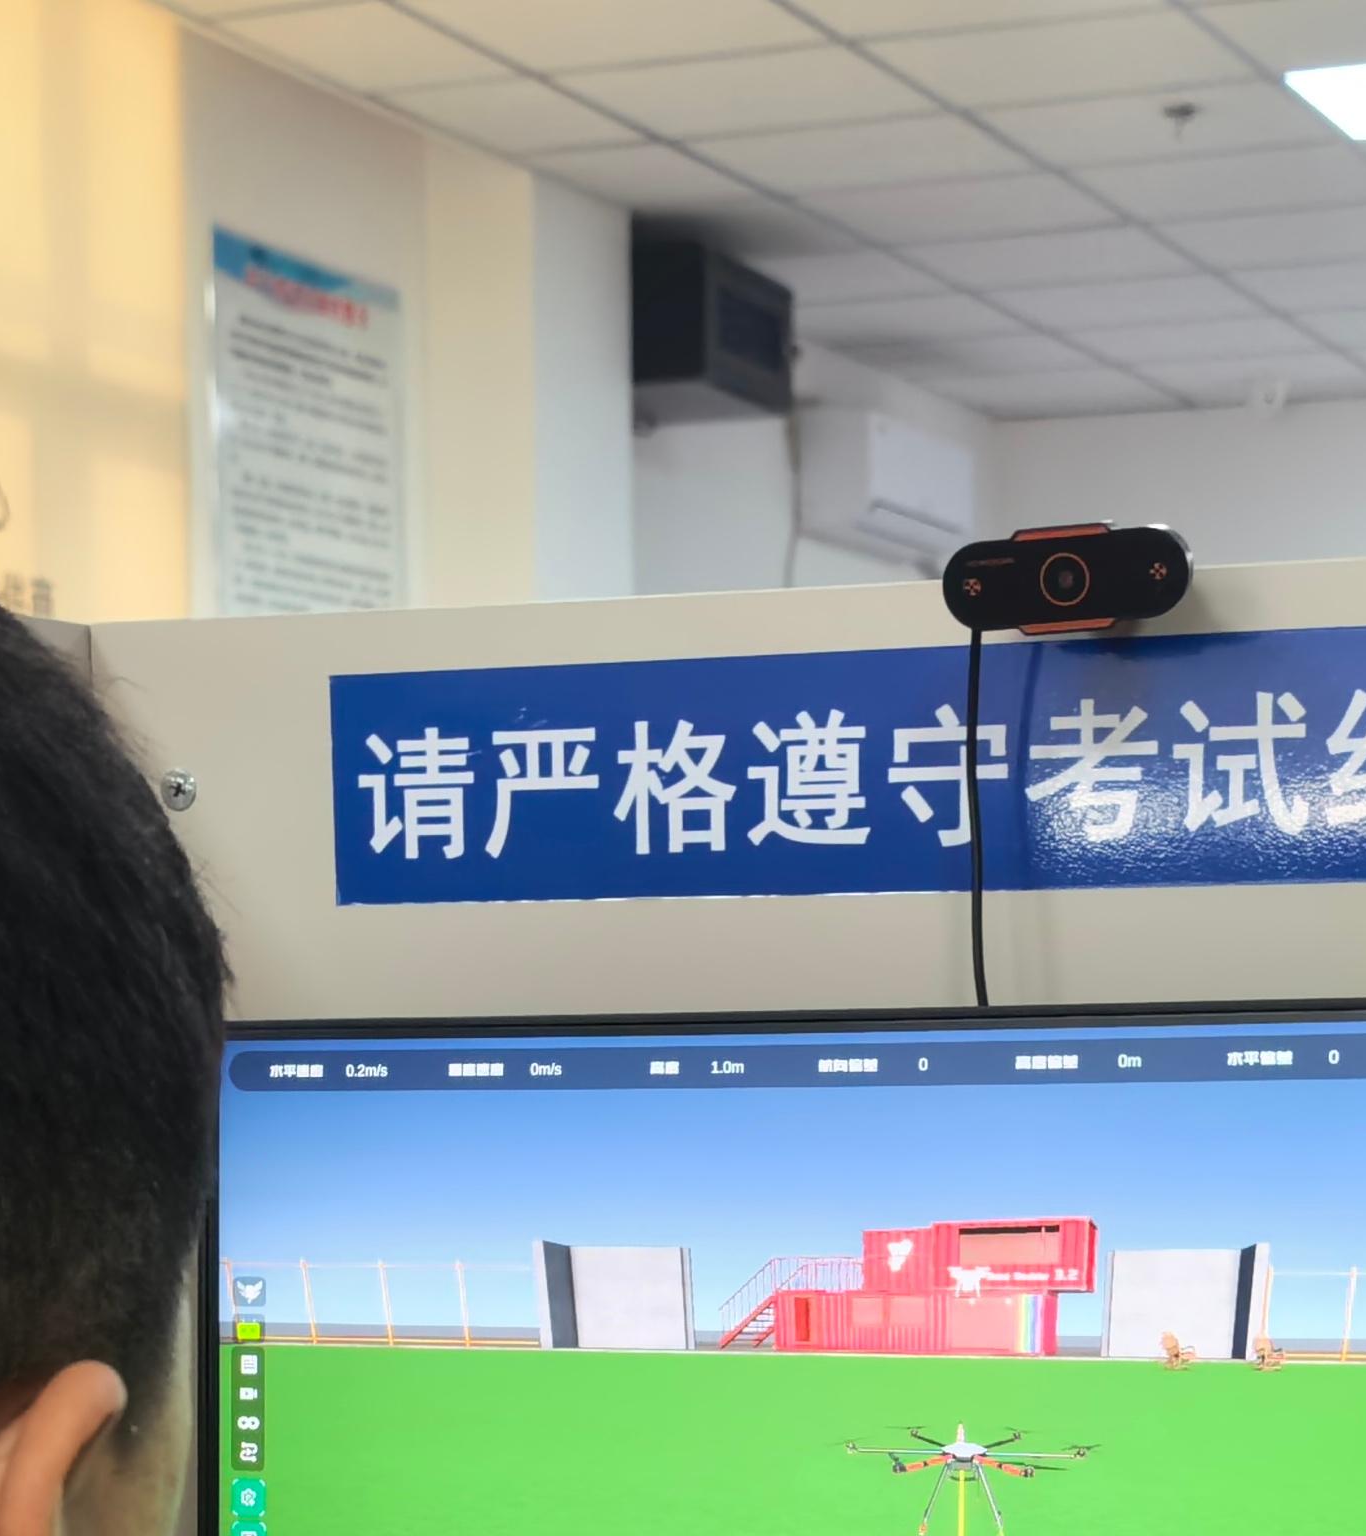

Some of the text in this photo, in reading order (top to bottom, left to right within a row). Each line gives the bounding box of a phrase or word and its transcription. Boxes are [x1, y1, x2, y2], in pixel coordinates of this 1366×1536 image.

[918, 1057, 928, 1072] 0
[1117, 1053, 1142, 1068] 0m
[1328, 1049, 1340, 1065] 0
[345, 1063, 389, 1078] 0.2m/s
[530, 1062, 562, 1077] 0m/s
[710, 1060, 745, 1074] 1.0m
